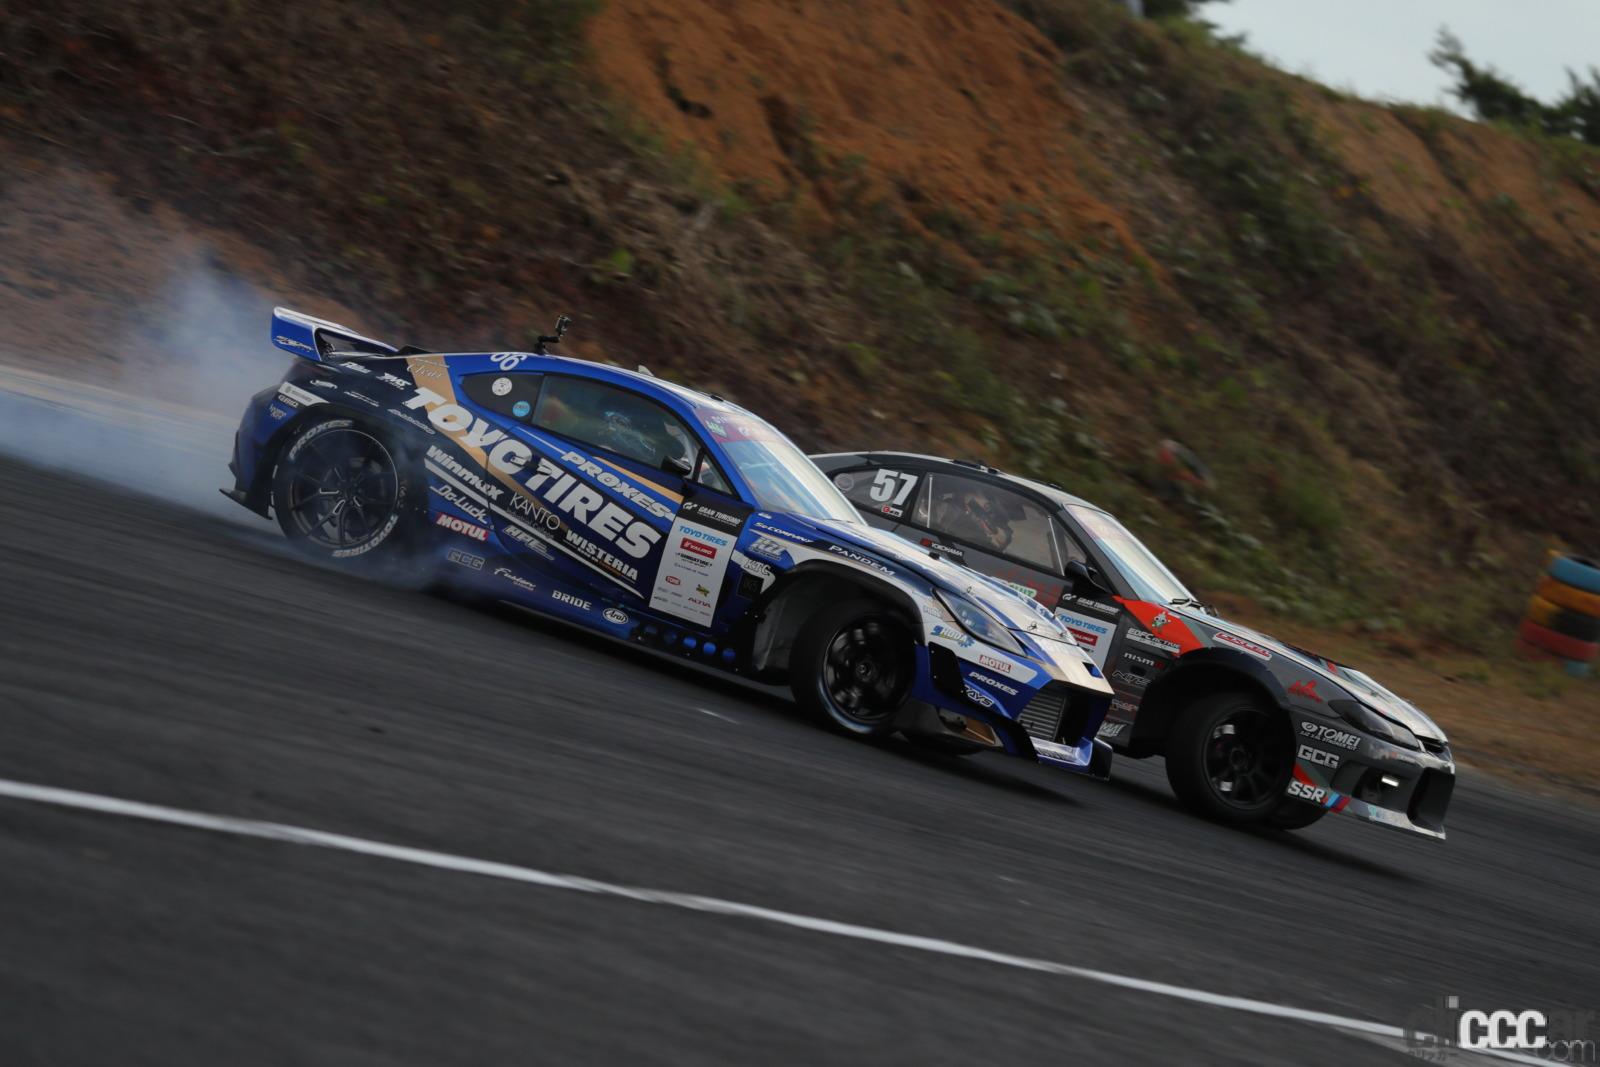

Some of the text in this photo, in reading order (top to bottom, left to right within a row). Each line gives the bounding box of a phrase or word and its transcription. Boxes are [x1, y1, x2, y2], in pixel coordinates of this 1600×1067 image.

[288, 420, 352, 461] PROXES
[562, 451, 677, 522] PROXES
[870, 468, 918, 505] 57
[509, 491, 561, 531] KANTO
[525, 457, 662, 559] TIRES
[436, 512, 488, 541] MOTUL
[678, 525, 728, 547] TOYO TIRES
[564, 529, 638, 581] WISTERIA
[828, 544, 896, 576] PANDEM
[551, 590, 592, 611] BRIDE
[1060, 614, 1108, 635] TOYO TIRES
[979, 655, 1011, 673] MOTUL
[968, 671, 1019, 695] PROXES
[1316, 722, 1361, 748] TOMEI
[1298, 744, 1340, 769] GCG
[1287, 780, 1325, 803] SSR
